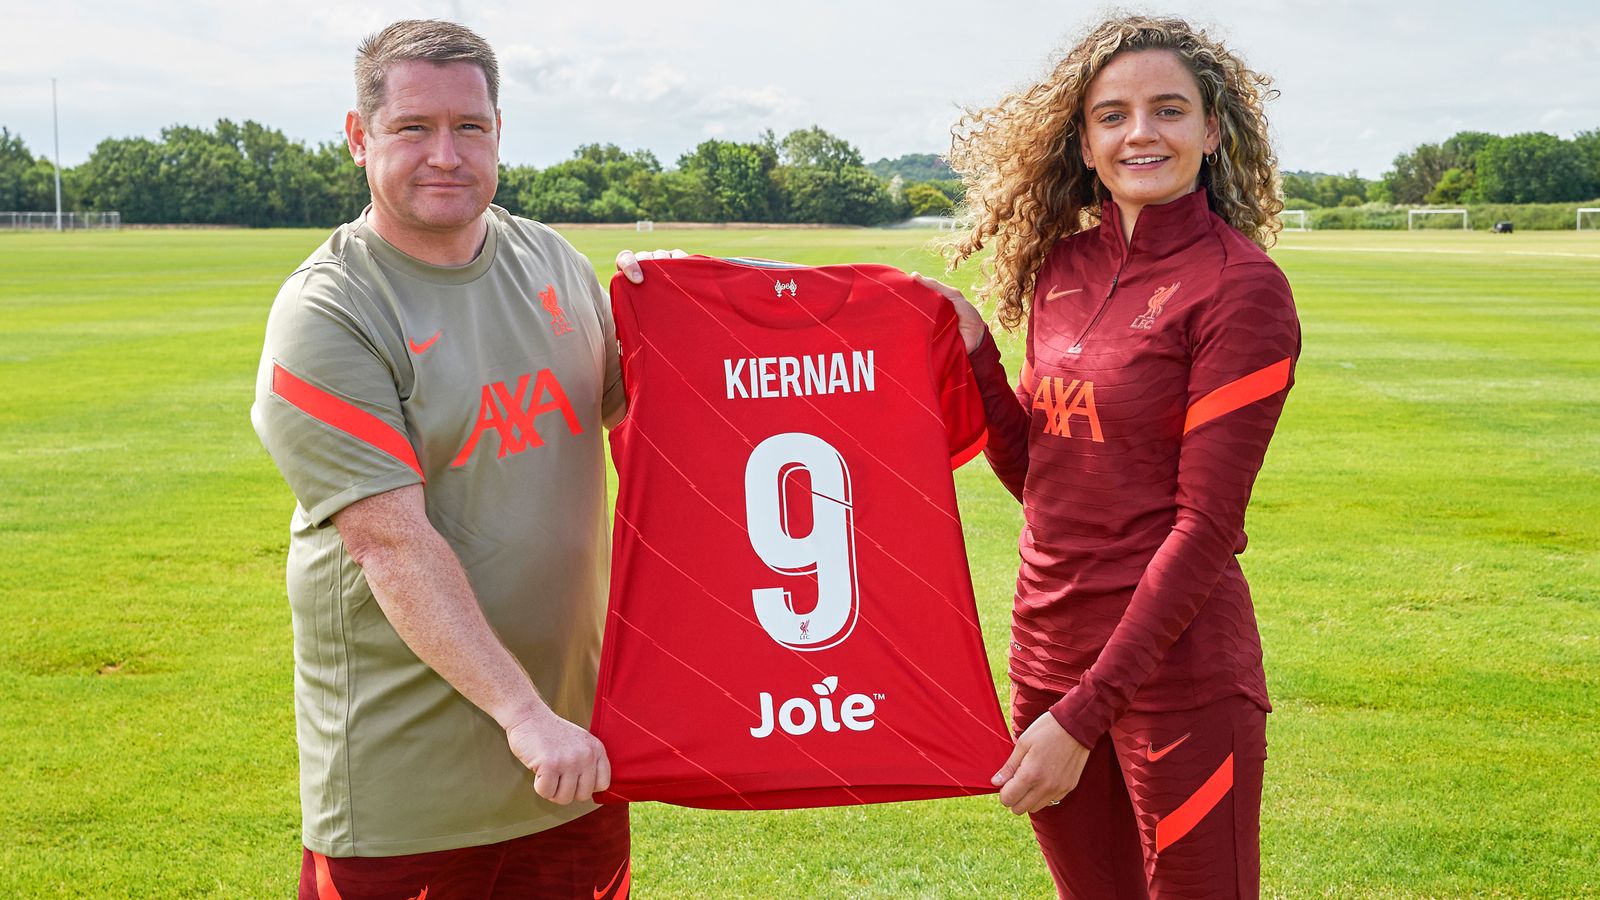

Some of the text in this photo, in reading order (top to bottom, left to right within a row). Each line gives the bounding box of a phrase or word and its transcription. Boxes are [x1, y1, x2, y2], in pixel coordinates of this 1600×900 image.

[1129, 317, 1155, 330] LFC
[724, 350, 875, 399] KIERNAN
[450, 368, 585, 467] AXA
[1032, 376, 1105, 443] AXA
[745, 432, 859, 652] 9
